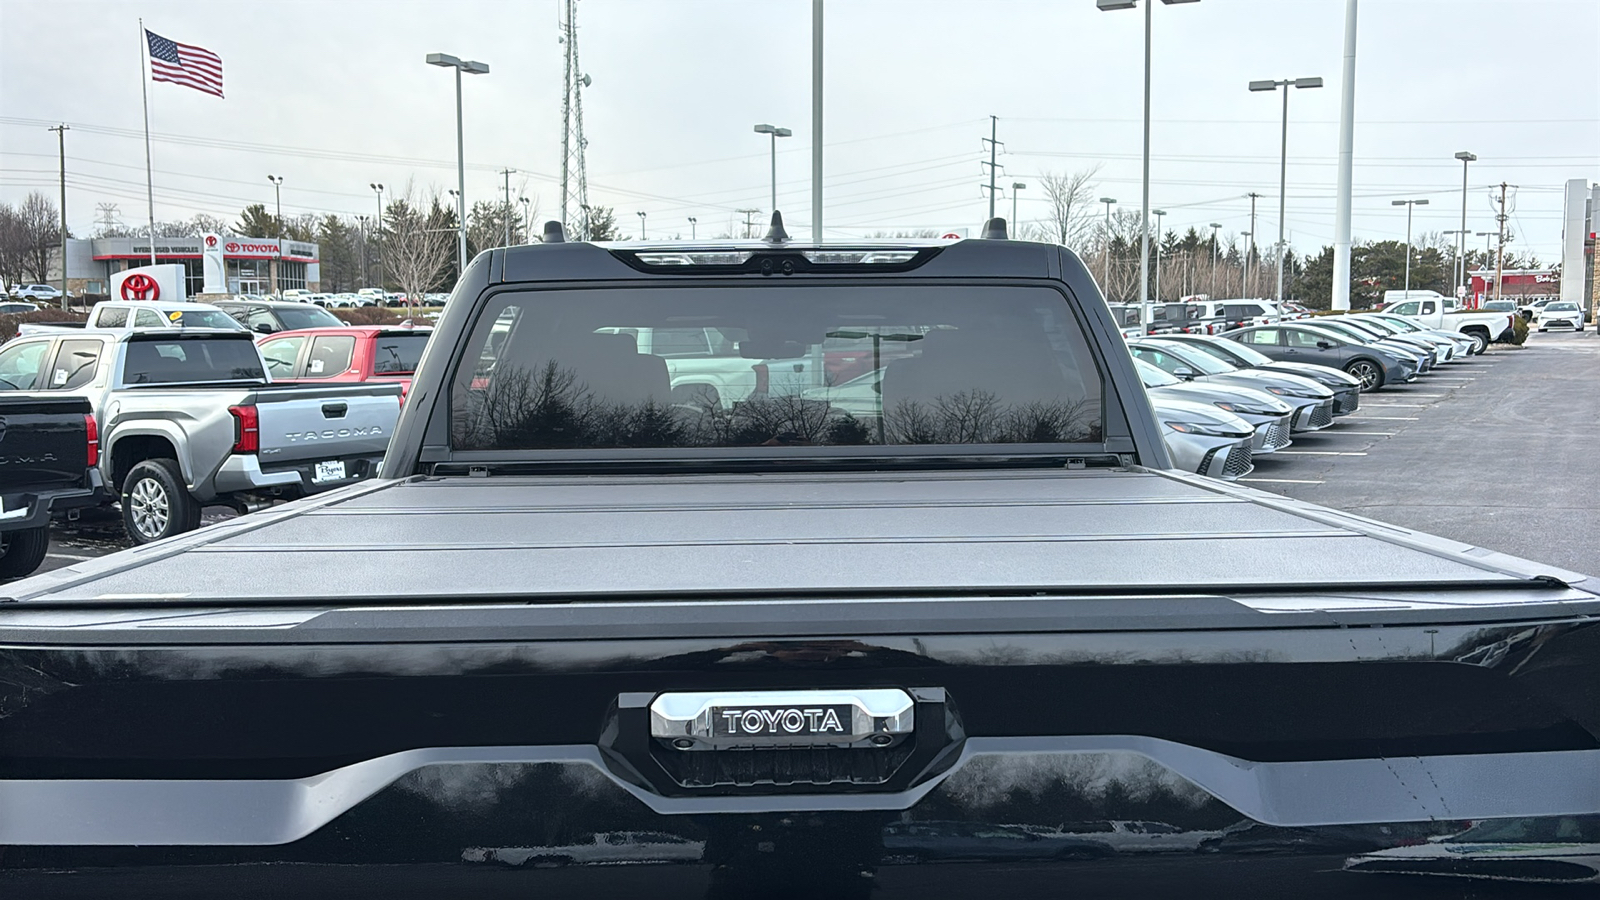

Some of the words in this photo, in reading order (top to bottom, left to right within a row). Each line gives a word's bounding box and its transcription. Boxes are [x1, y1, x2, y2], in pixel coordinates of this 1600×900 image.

[241, 244, 280, 252] TOYOTA
[285, 426, 383, 441] TACOMA
[722, 708, 844, 734] TOYOTA
